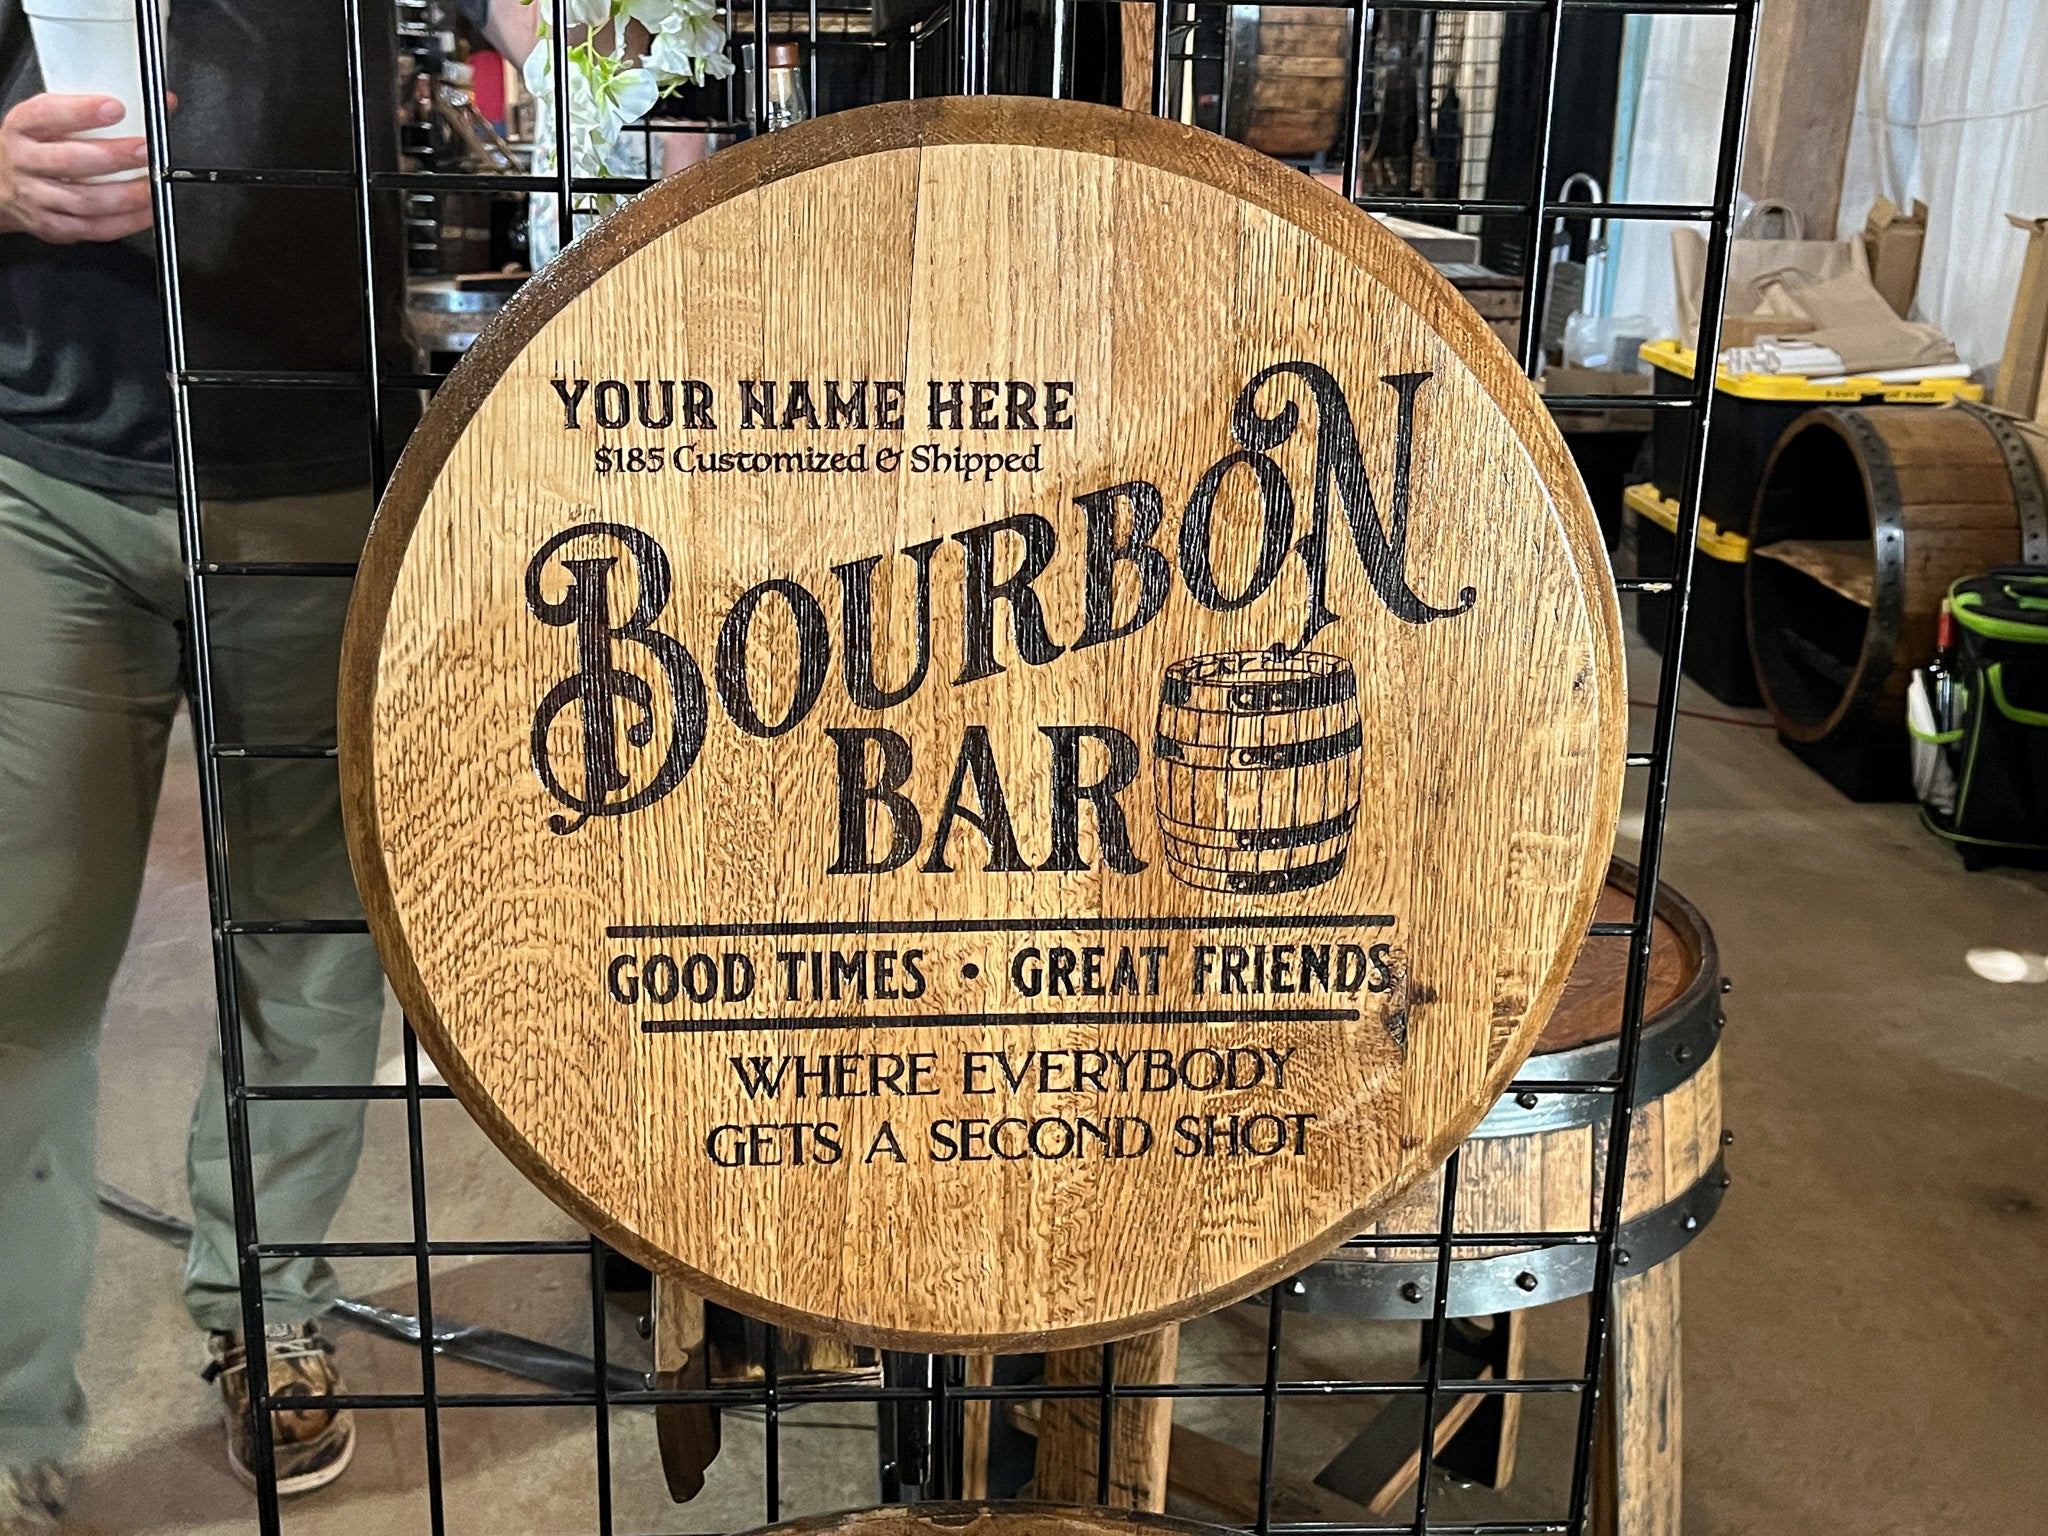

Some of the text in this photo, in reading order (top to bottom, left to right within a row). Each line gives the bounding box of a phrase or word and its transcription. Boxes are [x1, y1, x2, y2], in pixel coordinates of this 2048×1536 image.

[551, 379, 1075, 430] YOUR NAME HERE
[595, 443, 1044, 482] $185 Customized & Shipped
[525, 361, 1476, 836] BOURBON
[824, 724, 1150, 877] BAR
[608, 943, 1393, 1004] GOOD TIMES GREAT FRIENDS
[729, 1047, 1296, 1099] WHERE EVERYBODY
[706, 1113, 1318, 1167] GETS A SECOND SHOT
